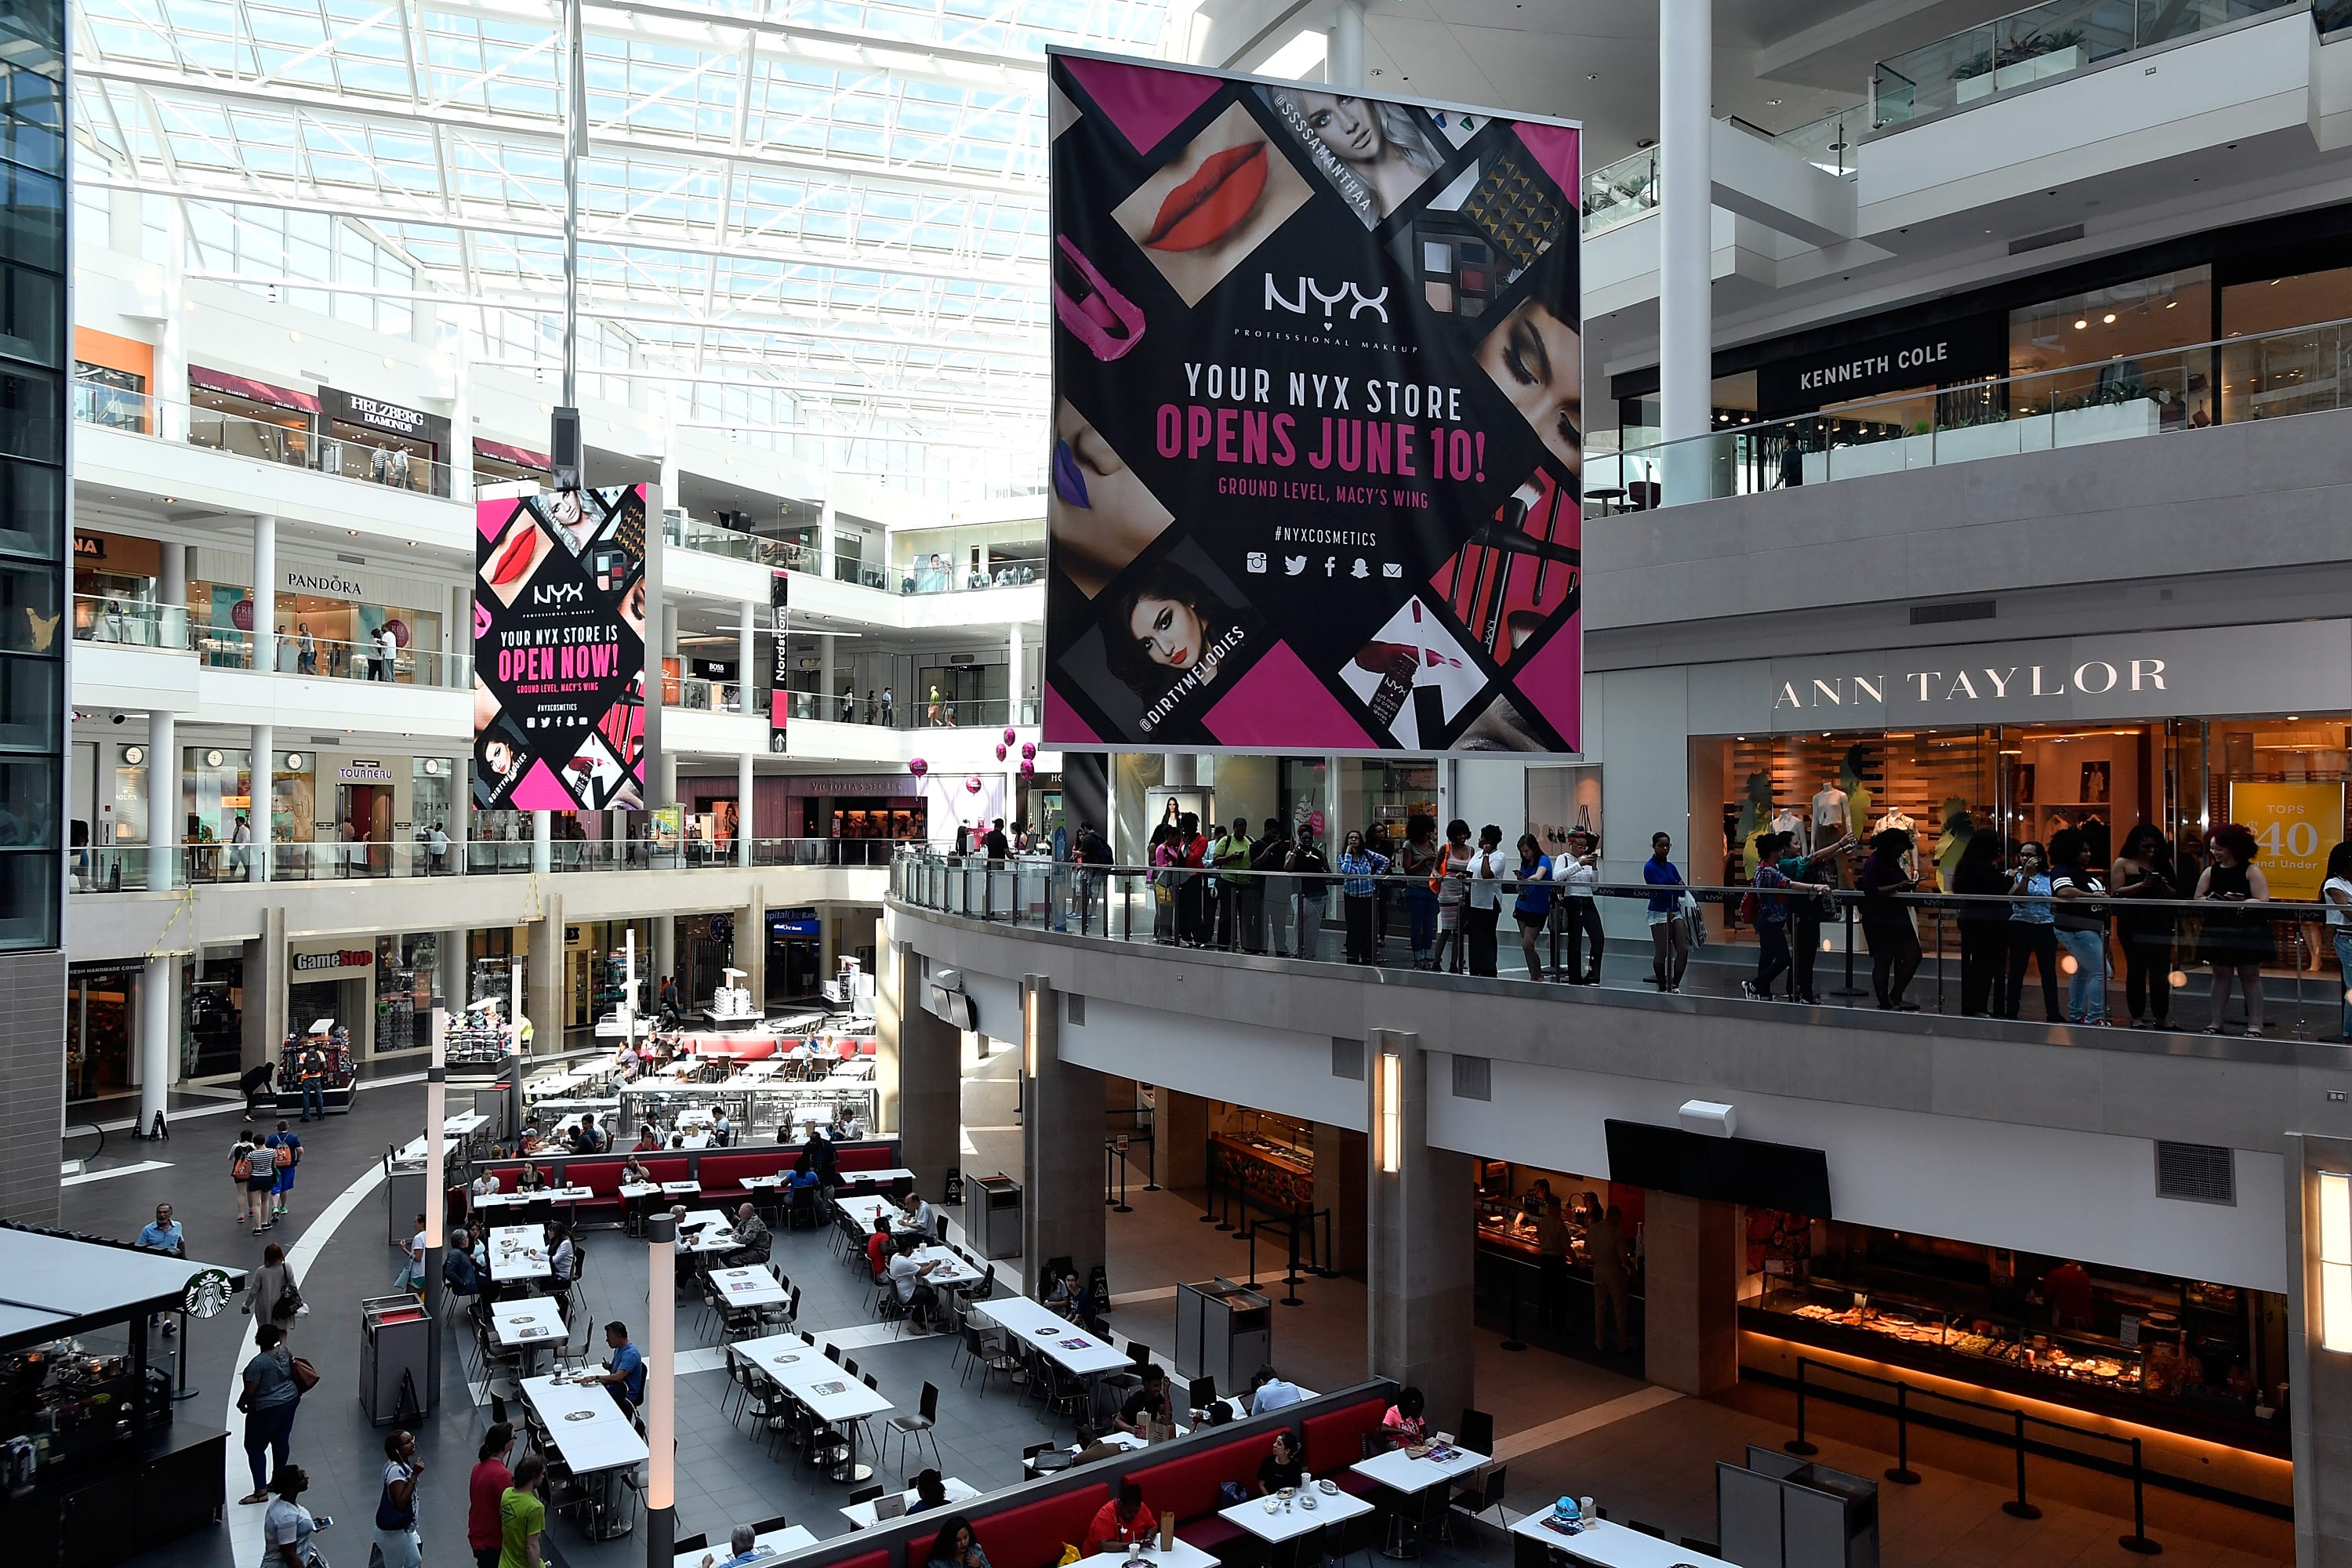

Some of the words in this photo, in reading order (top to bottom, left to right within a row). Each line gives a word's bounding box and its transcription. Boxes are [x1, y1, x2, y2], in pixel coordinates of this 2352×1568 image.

[1274, 94, 1370, 211] @SSSSAMANTHAA
[1265, 273, 1388, 323] NYX
[1234, 328, 1349, 347] PROFESSIONAL
[1361, 342, 1417, 353] MAKEUP
[1801, 355, 1889, 390] KENNETH
[1898, 342, 1947, 368] COLE
[1185, 362, 1269, 403] YOUR
[1290, 372, 1349, 410] NYX
[1367, 380, 1461, 421] STORE
[350, 396, 423, 426] HELZBERG
[364, 412, 412, 433] DIAMONDS
[1156, 403, 1297, 467] OPENS
[1308, 416, 1416, 477] JUNE
[1430, 427, 1486, 483] 10!
[1218, 477, 1277, 497] GROUND
[1284, 481, 1330, 503] LEVEL,
[1337, 485, 1388, 506] MACY'S
[1394, 491, 1428, 509] WING
[1275, 525, 1376, 546] #NYXCOSMETICS
[288, 573, 361, 595] PANDORA
[534, 583, 583, 604] NYX
[236, 605, 253, 615] FRE
[500, 630, 530, 647] YOUR
[536, 628, 559, 645] NYX
[564, 626, 600, 644] STORE
[606, 624, 618, 641] IS
[775, 606, 786, 681] Nordstom
[499, 647, 554, 681] OPEN
[561, 643, 619, 679] NOW!
[709, 662, 724, 671] BOSS
[517, 684, 539, 694] GROUND
[541, 684, 559, 694] LEVEL,
[583, 681, 598, 691] WING
[1139, 626, 1245, 732] @DIRTYMELODIES
[1773, 674, 1885, 709] ANN
[1906, 658, 2169, 702] TAYLOR
[488, 752, 528, 804] @DIRTYMELODIES
[866, 782, 902, 791] SECRET
[2267, 804, 2305, 814] TOPS
[2247, 819, 2318, 857] $40
[2281, 859, 2318, 869] Under
[296, 949, 372, 970] GameStop
